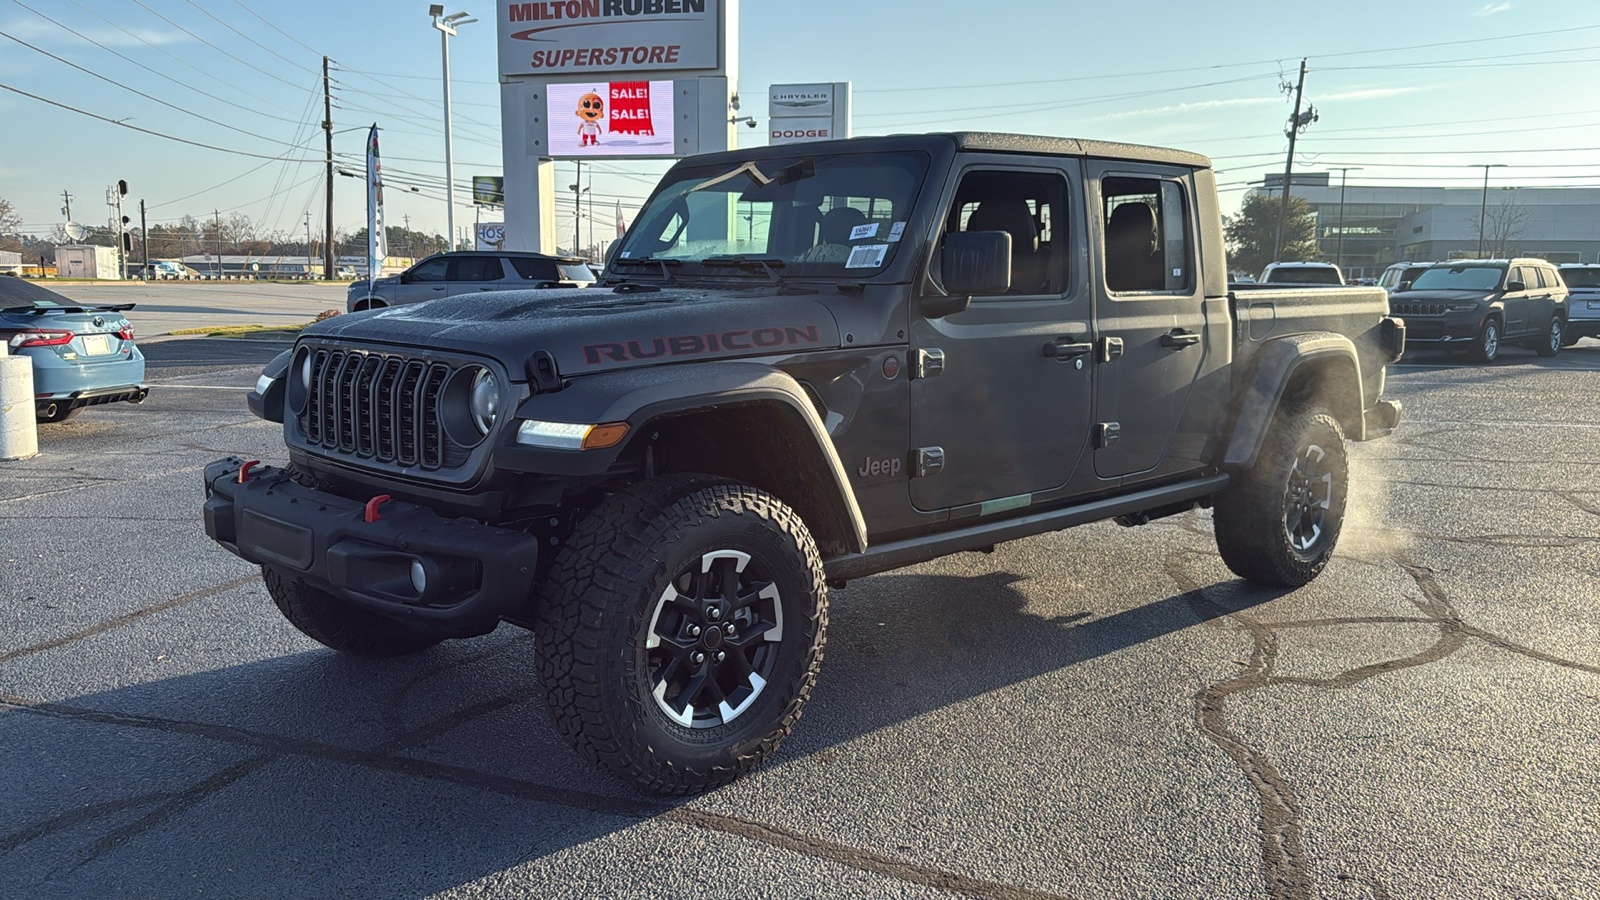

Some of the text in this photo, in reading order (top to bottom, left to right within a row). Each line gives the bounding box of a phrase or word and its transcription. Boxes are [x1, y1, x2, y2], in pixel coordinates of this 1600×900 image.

[509, 0, 705, 22] MILTON RUBEN
[531, 45, 681, 68] SUPERSTORE
[611, 88, 648, 99] SALE!
[611, 109, 649, 119] SALE!
[772, 130, 828, 138] DODGE
[581, 324, 820, 365] RUBICON
[857, 456, 901, 477] Jeep
